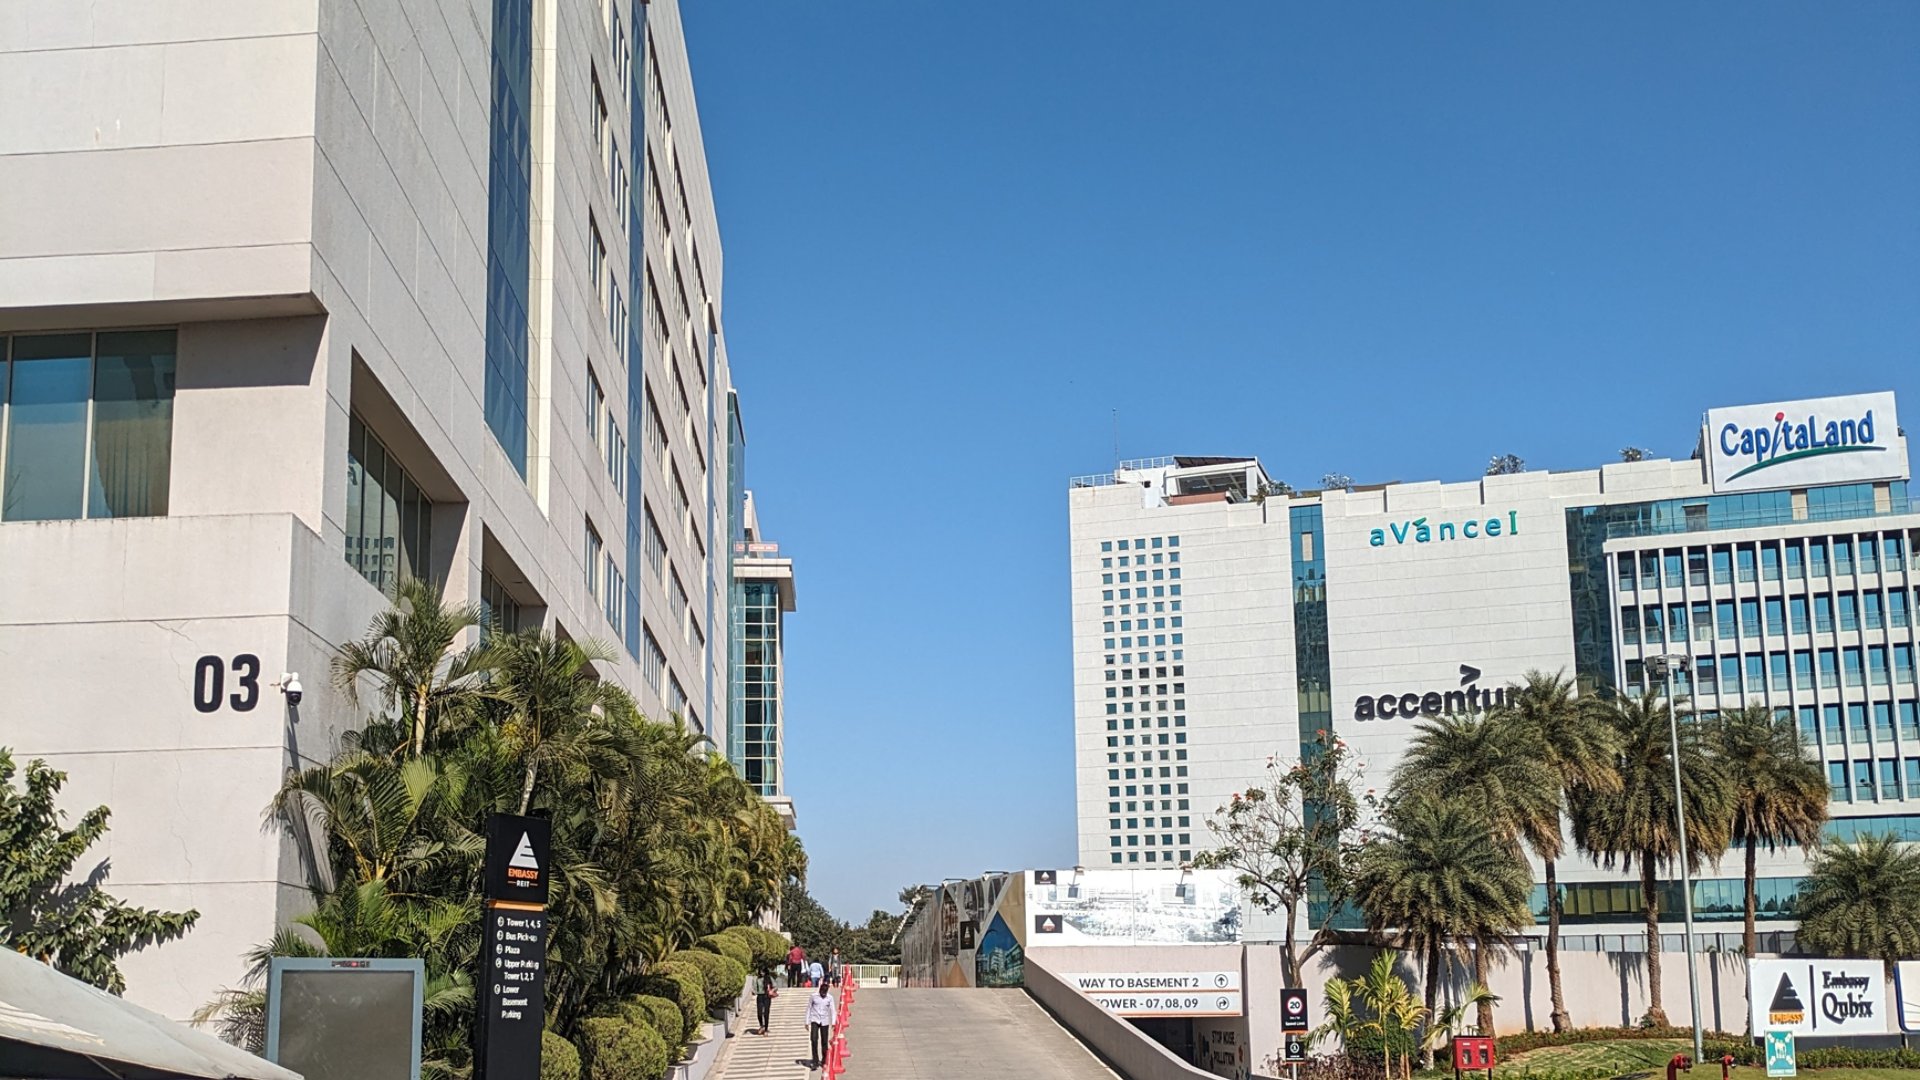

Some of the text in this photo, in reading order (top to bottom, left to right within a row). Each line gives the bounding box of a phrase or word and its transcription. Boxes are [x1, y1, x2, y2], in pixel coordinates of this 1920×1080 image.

[1720, 410, 1875, 461] CapitaLand
[194, 653, 261, 713] 03
[1354, 682, 1536, 721] accentur
[508, 868, 539, 880] EMBASSY
[516, 880, 530, 888] REIT
[507, 917, 524, 927] Tower
[1079, 977, 1200, 989] WAY TO BASEMENT 2
[1822, 971, 1870, 993] Embassy
[1097, 998, 1138, 1009] OWER
[1289, 1001, 1301, 1010] 20
[1822, 992, 1873, 1025] Qubix
